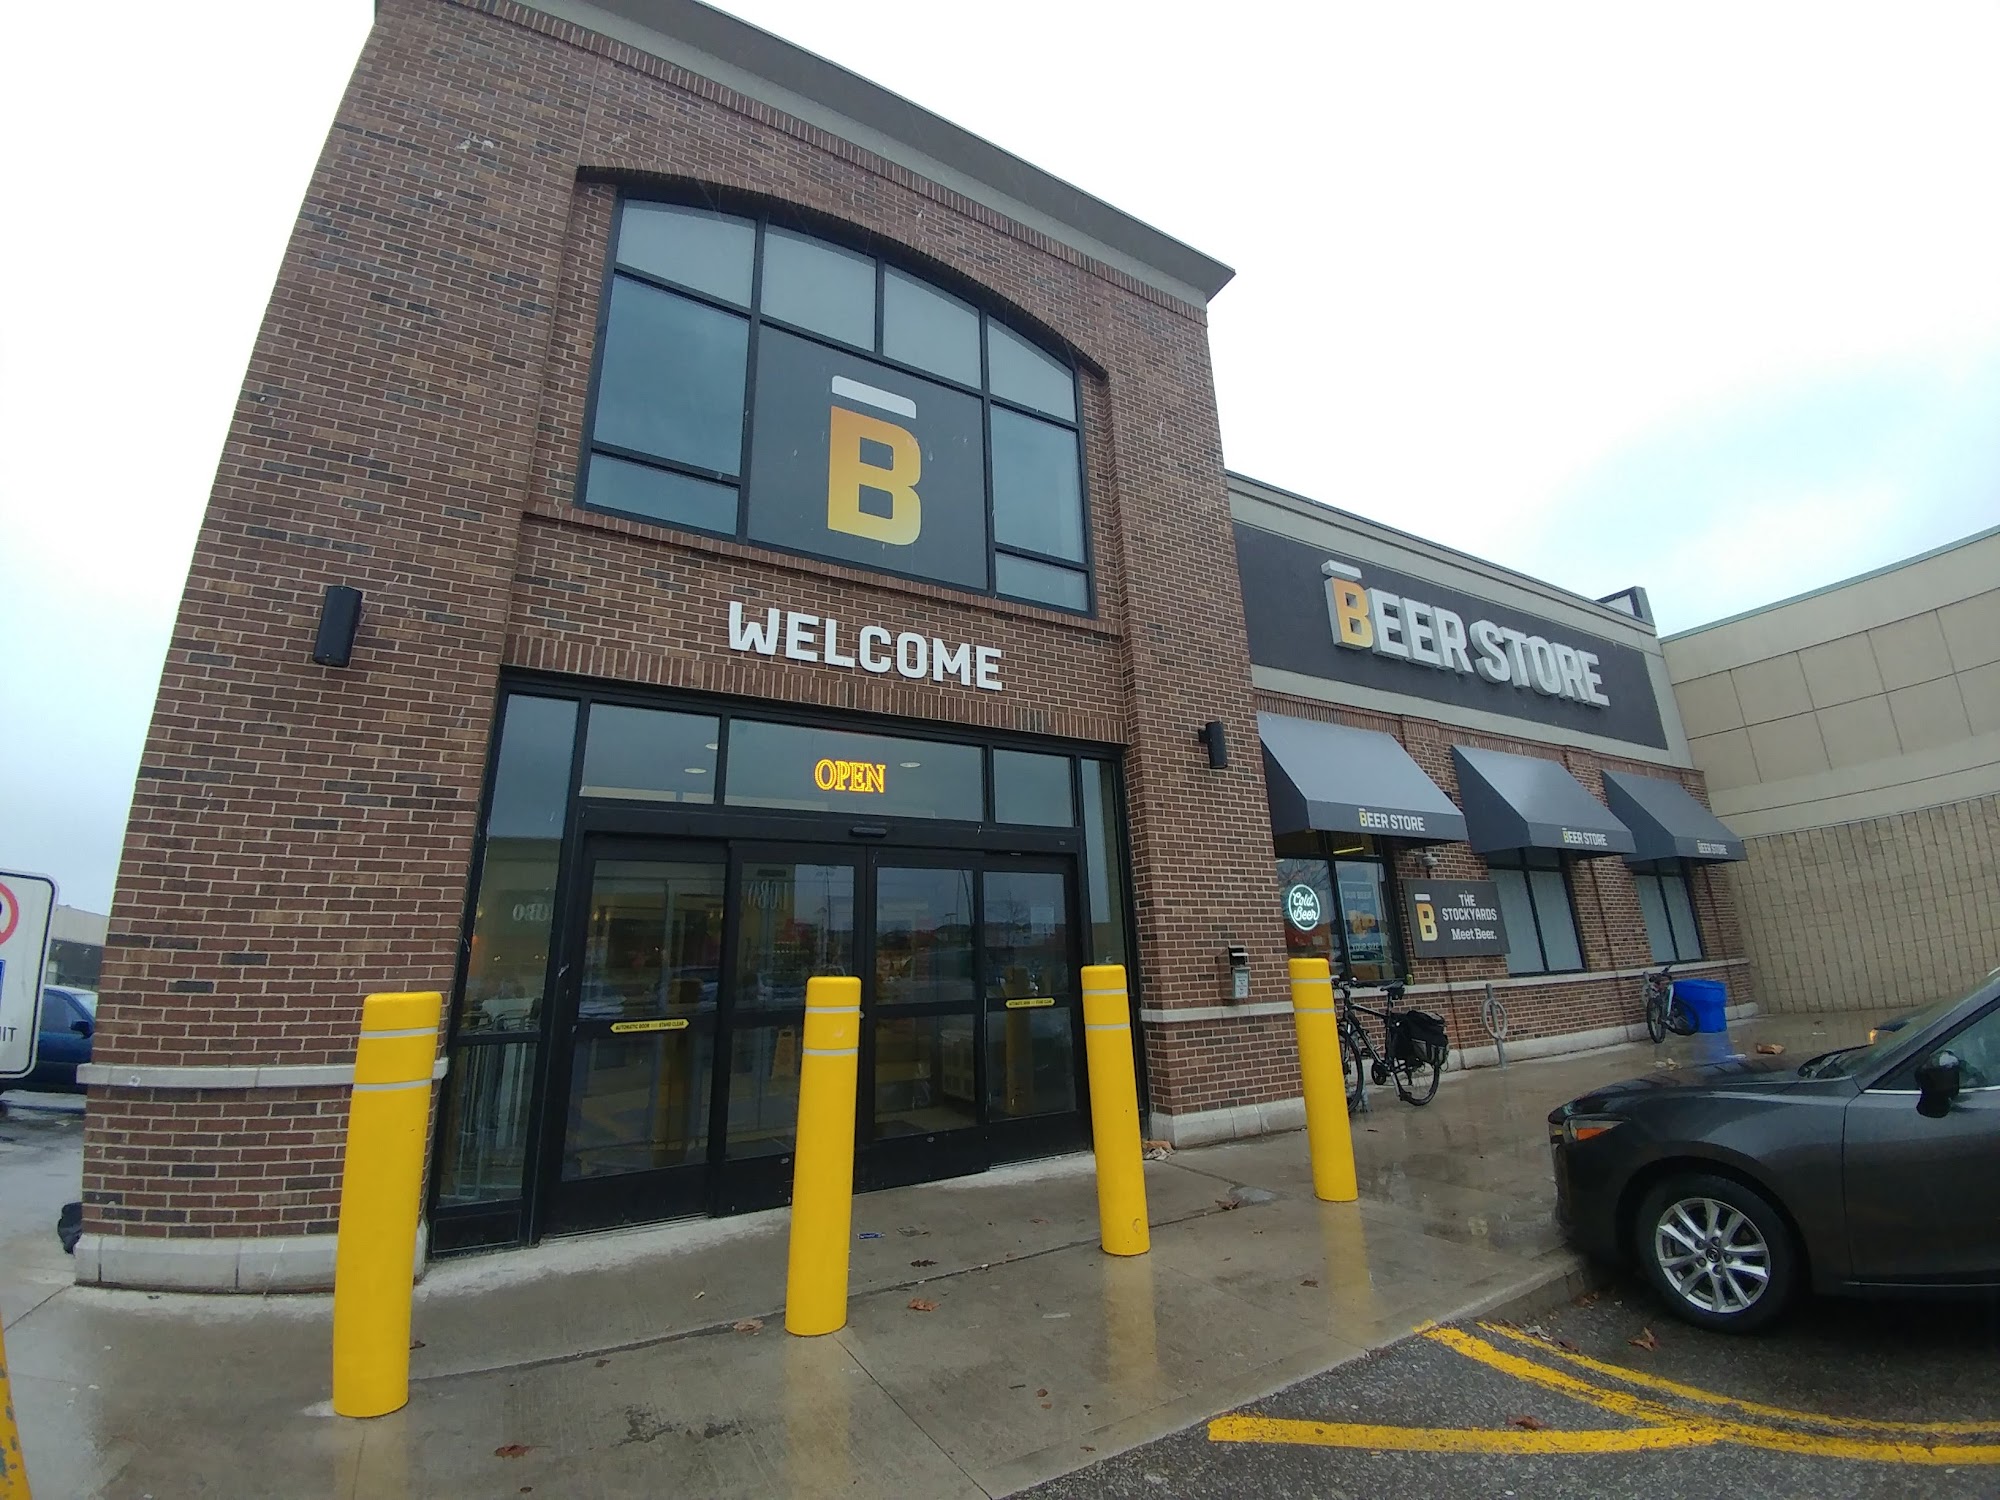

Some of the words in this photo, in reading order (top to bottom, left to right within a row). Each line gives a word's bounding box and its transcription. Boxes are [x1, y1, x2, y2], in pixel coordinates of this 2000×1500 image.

[1321, 560, 1475, 675] BEER
[1469, 619, 1611, 708] STORE
[728, 601, 1003, 692] WELCOME
[814, 758, 886, 793] OPEN
[1358, 808, 1389, 829] BEER
[1390, 814, 1426, 832] STORE
[1561, 827, 1584, 844] BEER
[1583, 832, 1608, 846] STORE
[1292, 892, 1315, 906] Cold
[1458, 894, 1476, 907] THE
[1293, 906, 1318, 921] Beer
[1441, 907, 1498, 921] STOCKYARDS
[1450, 928, 1475, 941] Meet
[1474, 927, 1498, 940] Beer.
